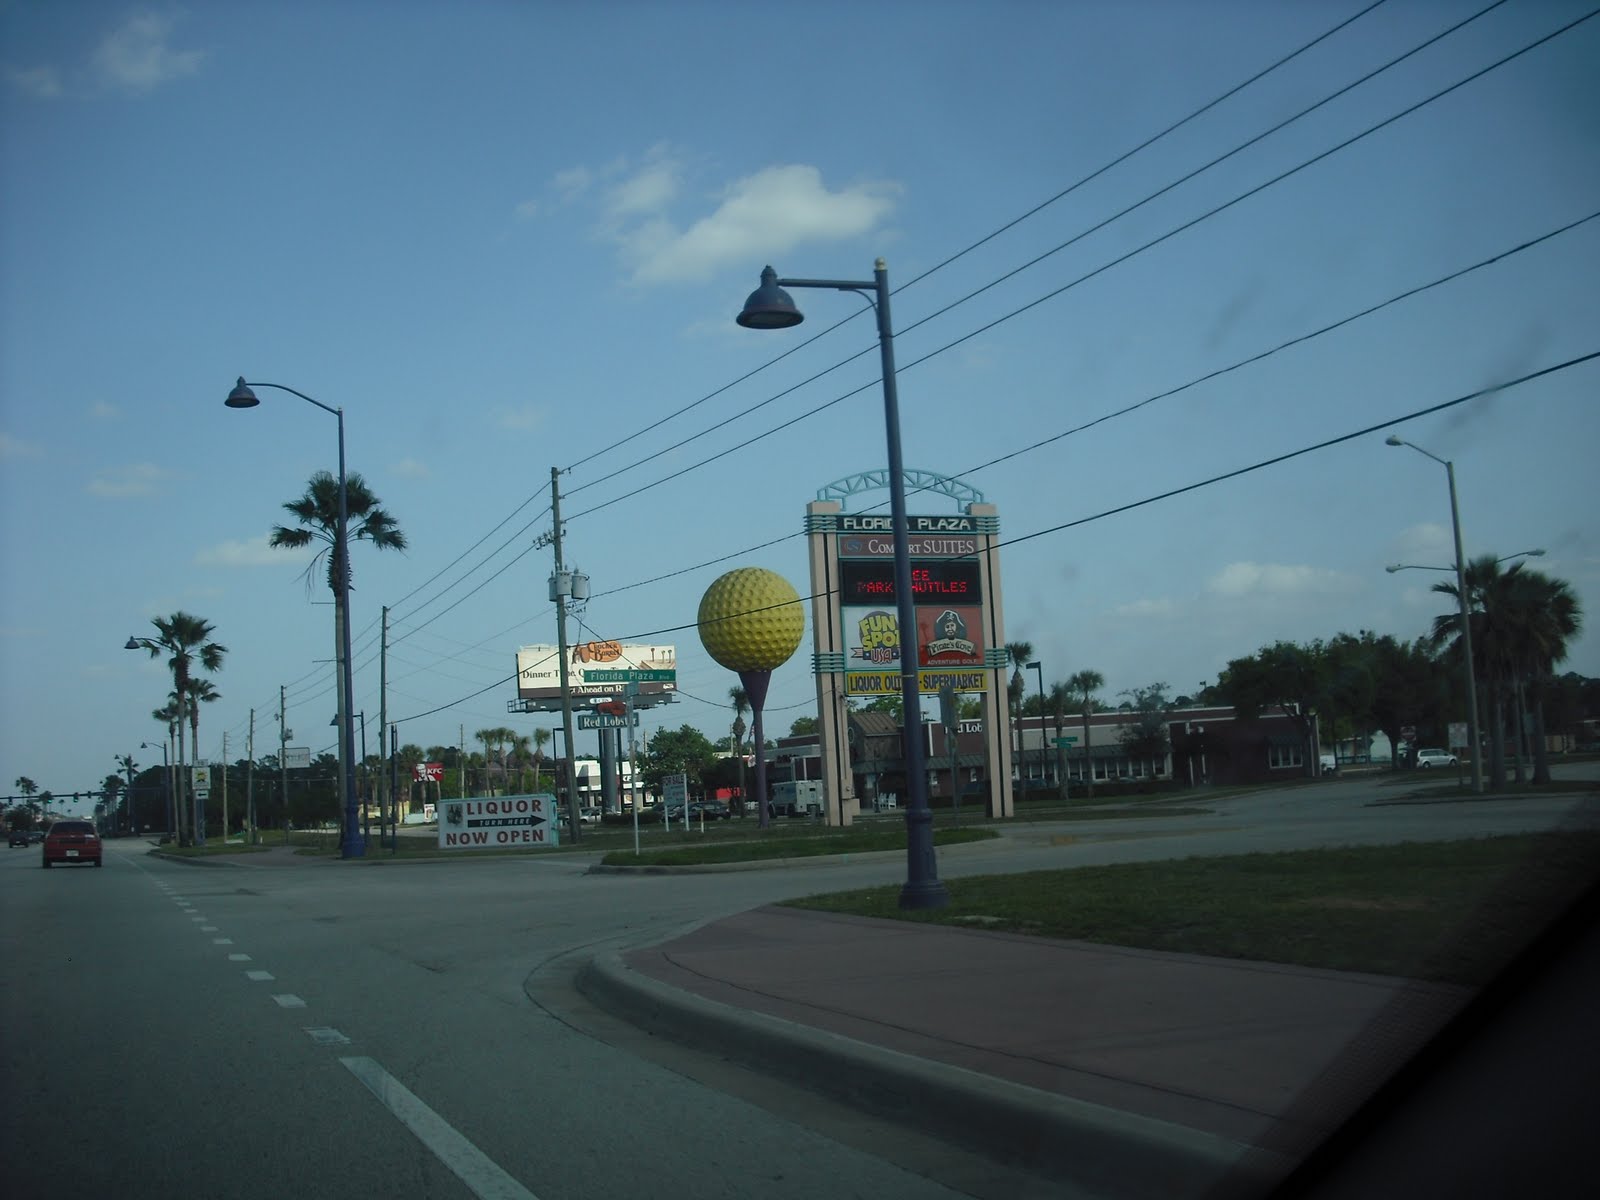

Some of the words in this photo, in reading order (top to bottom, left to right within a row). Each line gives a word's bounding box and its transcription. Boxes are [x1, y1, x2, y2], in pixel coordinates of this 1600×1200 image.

[843, 517, 909, 530] FLORID
[917, 518, 971, 530] PLAZA
[868, 539, 921, 553] COMRT
[923, 540, 974, 553] SUITES
[911, 581, 967, 593] HUTTLES
[859, 614, 896, 635] FUN
[871, 648, 893, 665] USA
[522, 670, 552, 679] Dinner
[591, 672, 624, 681] Florida
[629, 671, 654, 680] Plaza
[850, 676, 881, 691] LIQUOR
[885, 674, 903, 690] OUT
[924, 673, 984, 689] SUPERMARKET
[578, 686, 602, 694] Ahead
[584, 717, 600, 727] Red
[604, 716, 637, 727] Lobstr
[467, 799, 542, 815] LIQUOR
[479, 819, 503, 827] TURN
[508, 818, 531, 826] HERE
[446, 831, 488, 845] NOW
[496, 829, 544, 843] OPEN
